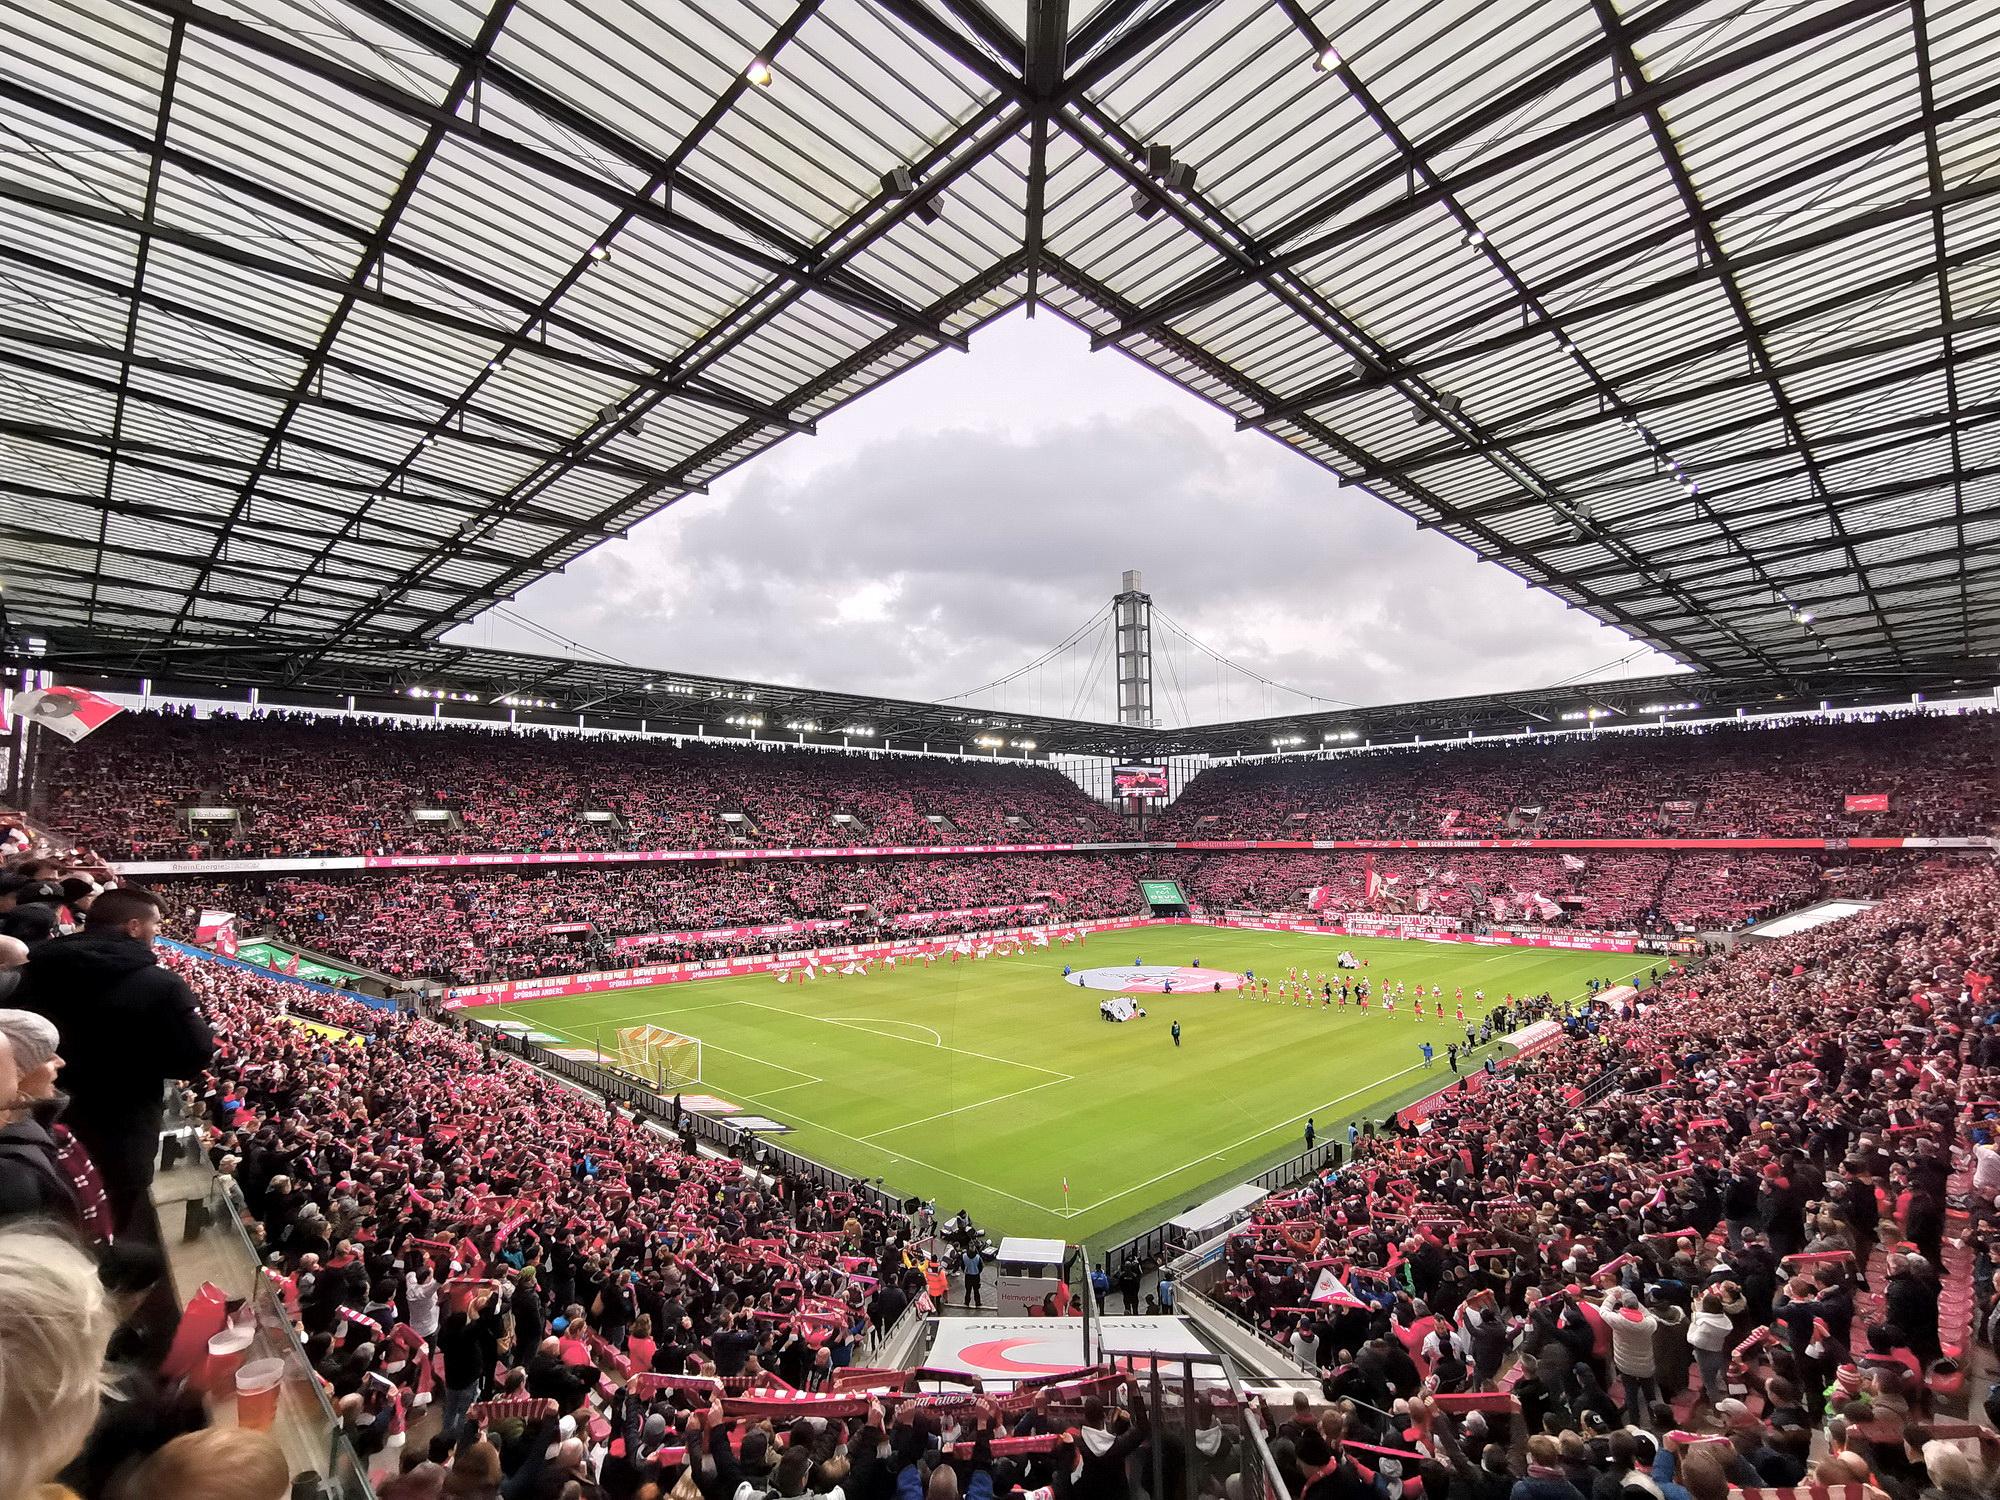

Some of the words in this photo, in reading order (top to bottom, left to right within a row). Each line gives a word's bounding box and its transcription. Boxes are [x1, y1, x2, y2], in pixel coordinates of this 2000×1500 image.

[733, 957, 752, 966] REWE
[778, 952, 797, 961] REWE
[577, 973, 601, 983] REWE
[603, 972, 614, 980] DEIN
[614, 970, 627, 978] MARKT
[633, 967, 657, 977] REWE
[692, 970, 713, 978] SPÜRBAR
[713, 968, 731, 976] ANDERS.
[515, 980, 543, 990] REWE
[544, 978, 556, 987] DEIN
[556, 976, 571, 985] MARKT
[608, 979, 633, 988] SPÜRBAR
[634, 976, 653, 986] ANDERS.
[513, 989, 541, 1000] SPÜRBAR
[542, 987, 564, 997] ANDERS.
